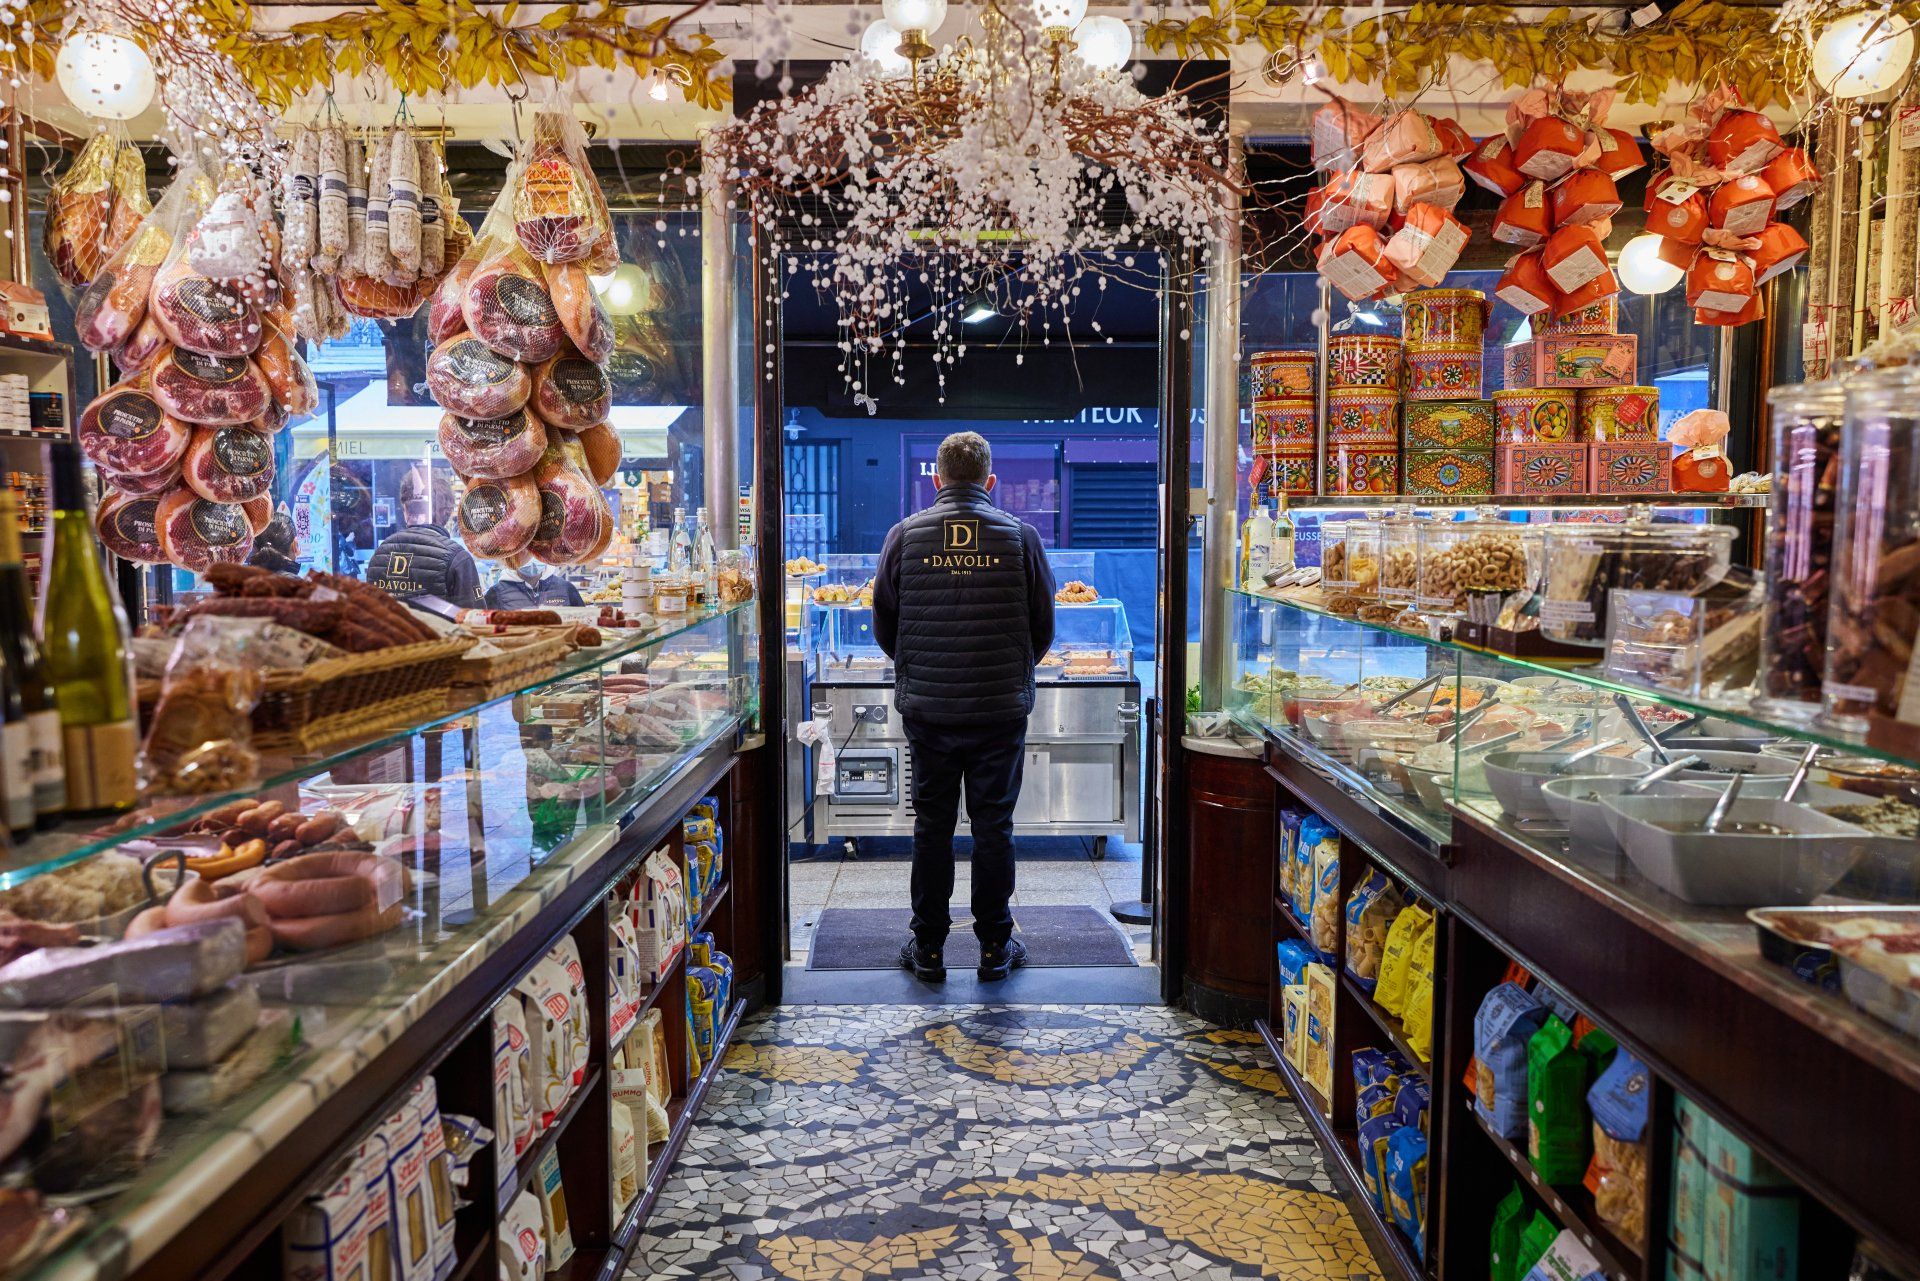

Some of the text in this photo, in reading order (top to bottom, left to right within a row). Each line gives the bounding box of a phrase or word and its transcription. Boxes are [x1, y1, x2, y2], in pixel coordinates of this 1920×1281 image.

[950, 524, 972, 547] D
[391, 555, 407, 575] D
[932, 555, 991, 567] DAVOLI
[378, 579, 417, 592] DAVOLI
[612, 1089, 642, 1099] RUMMO
